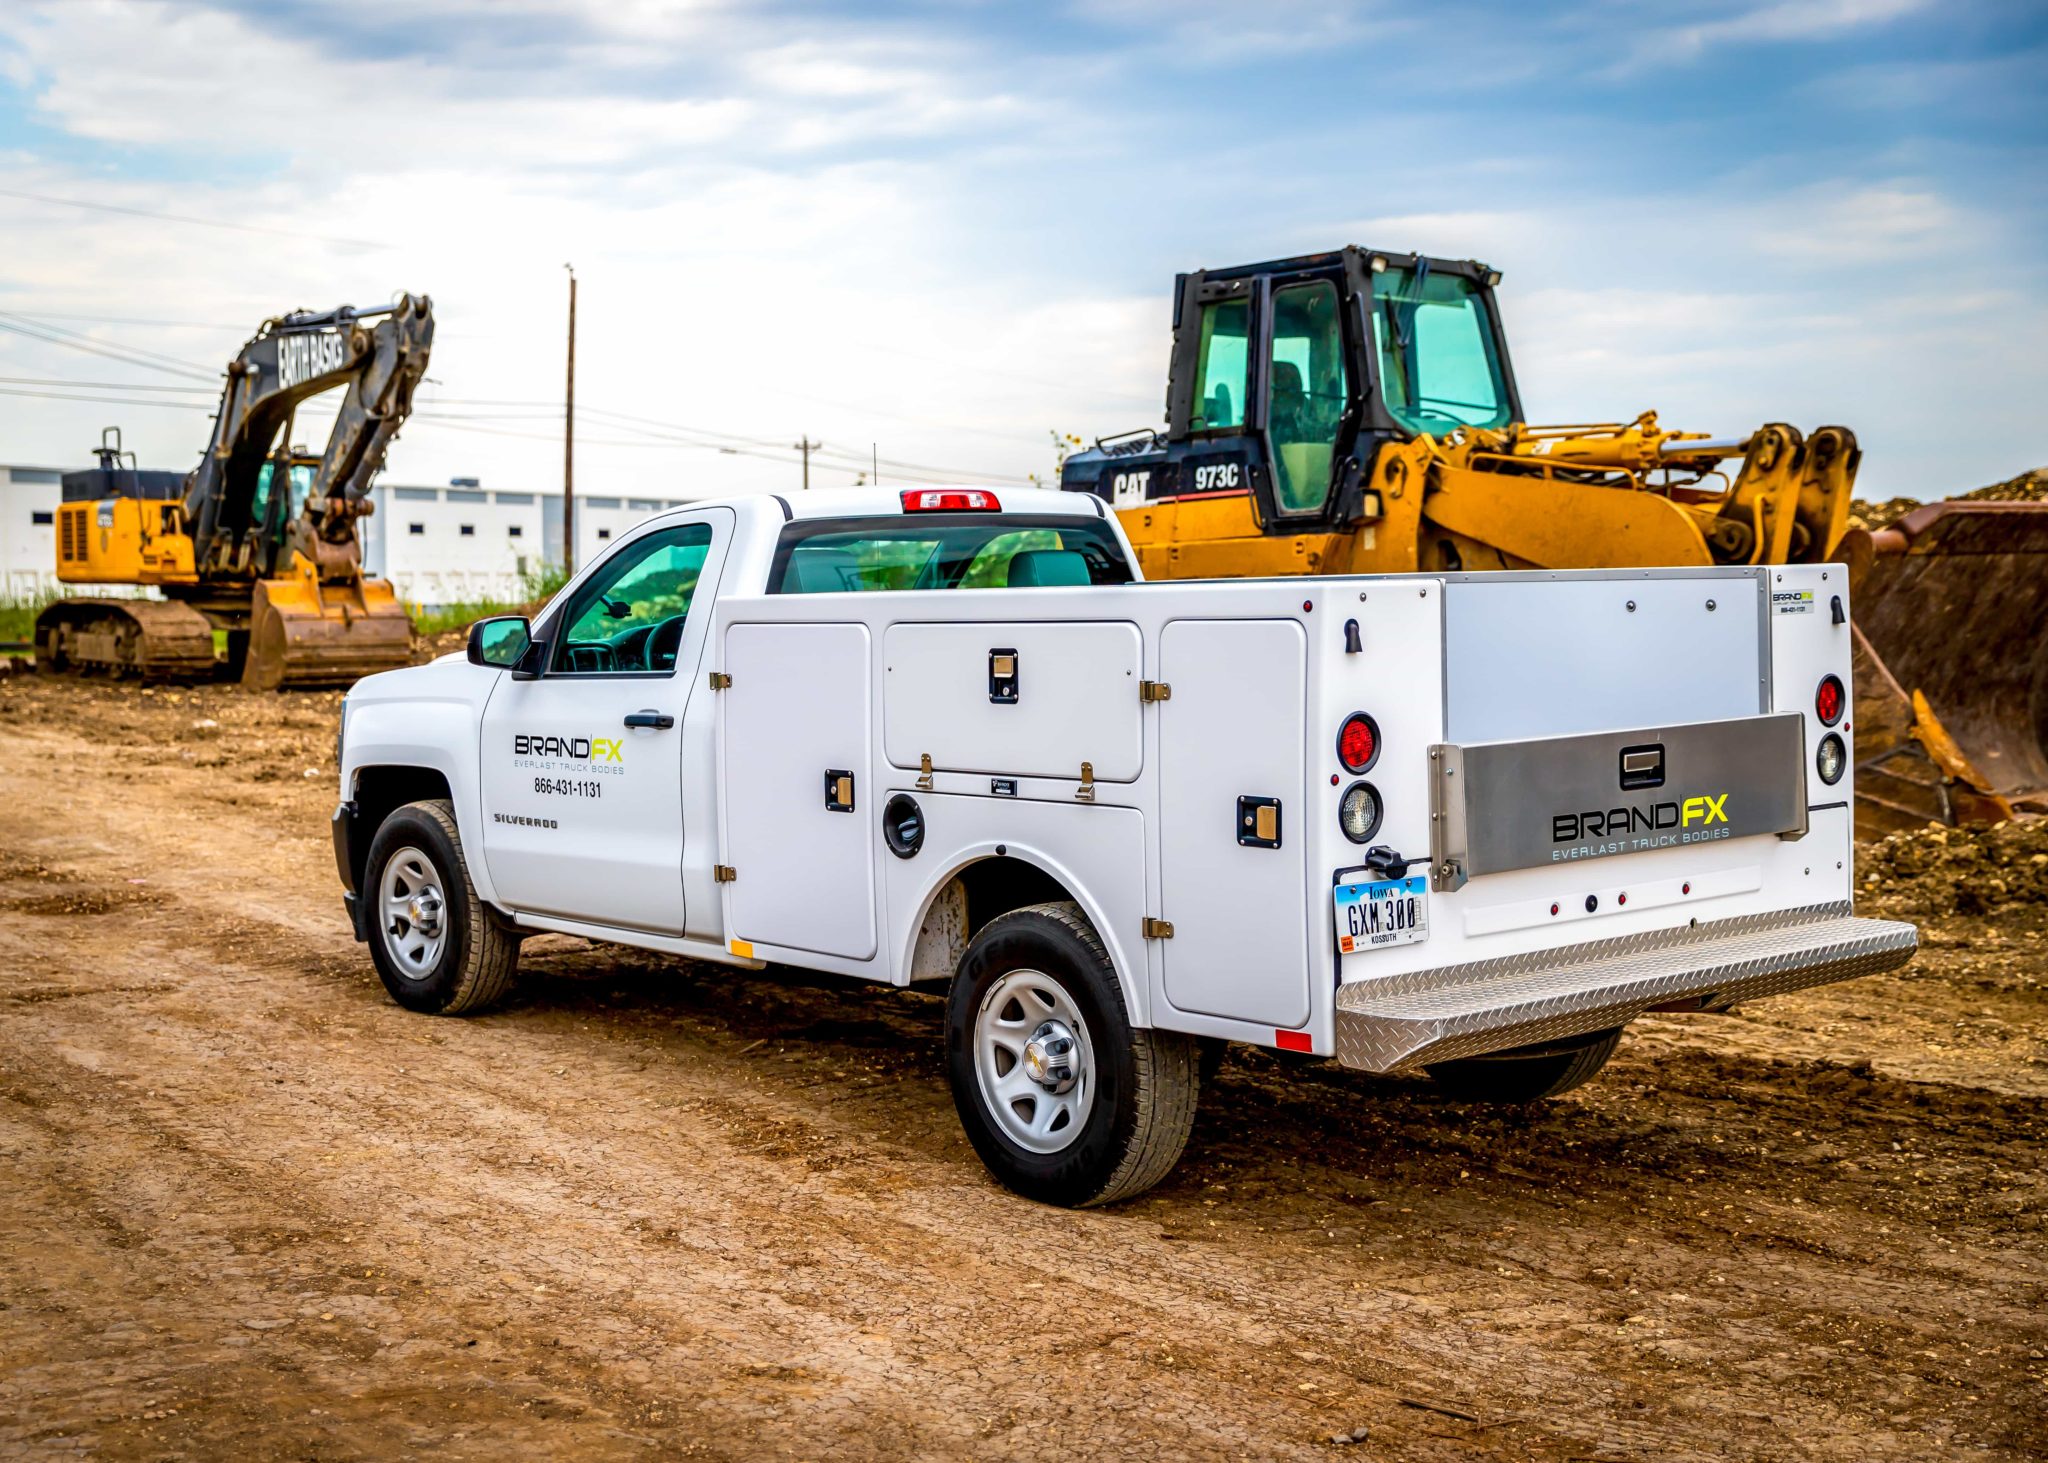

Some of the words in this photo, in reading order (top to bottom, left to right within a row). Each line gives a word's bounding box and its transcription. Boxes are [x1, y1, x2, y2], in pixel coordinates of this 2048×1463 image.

[1195, 463, 1239, 490] 973C
[1114, 471, 1150, 508] CAT
[514, 760, 555, 769] EVERLAST
[559, 762, 588, 772] TRUCK
[591, 765, 624, 775] BODIES
[534, 777, 601, 798] 866-431-1131
[494, 813, 558, 829] SILVERADO
[1552, 841, 1626, 861] EVERLAST
[1632, 834, 1677, 849] TRUCK
[1682, 827, 1730, 843] BODIES
[1347, 902, 1380, 937] GXM
[1385, 897, 1416, 931] 300
[1371, 933, 1397, 945] KOSSUTH
